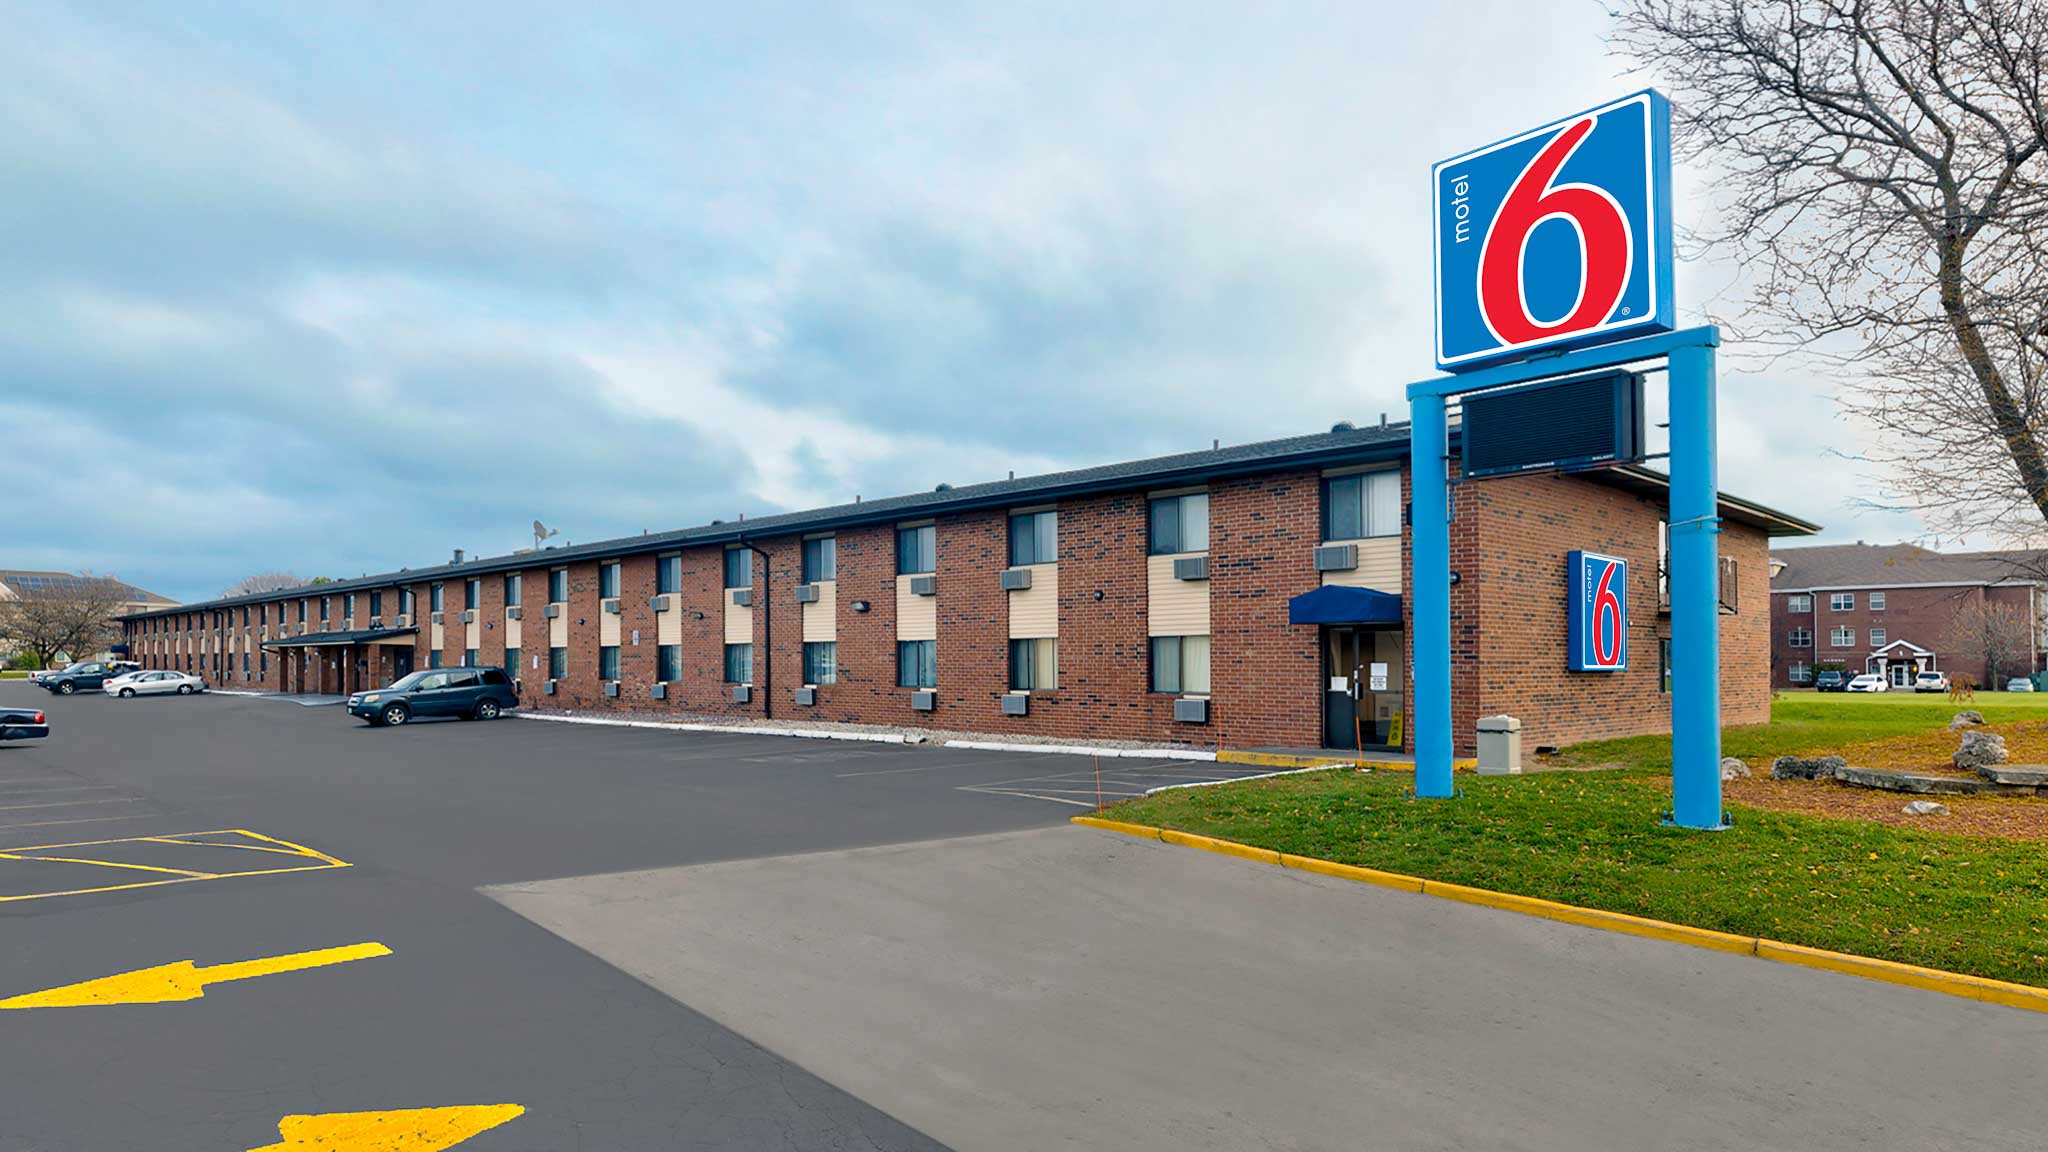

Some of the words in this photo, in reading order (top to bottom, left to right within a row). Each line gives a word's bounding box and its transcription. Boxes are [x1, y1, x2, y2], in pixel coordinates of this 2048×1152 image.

[1451, 174, 1470, 243] motel
[1477, 114, 1633, 346] 6
[1592, 560, 1622, 667] 6
